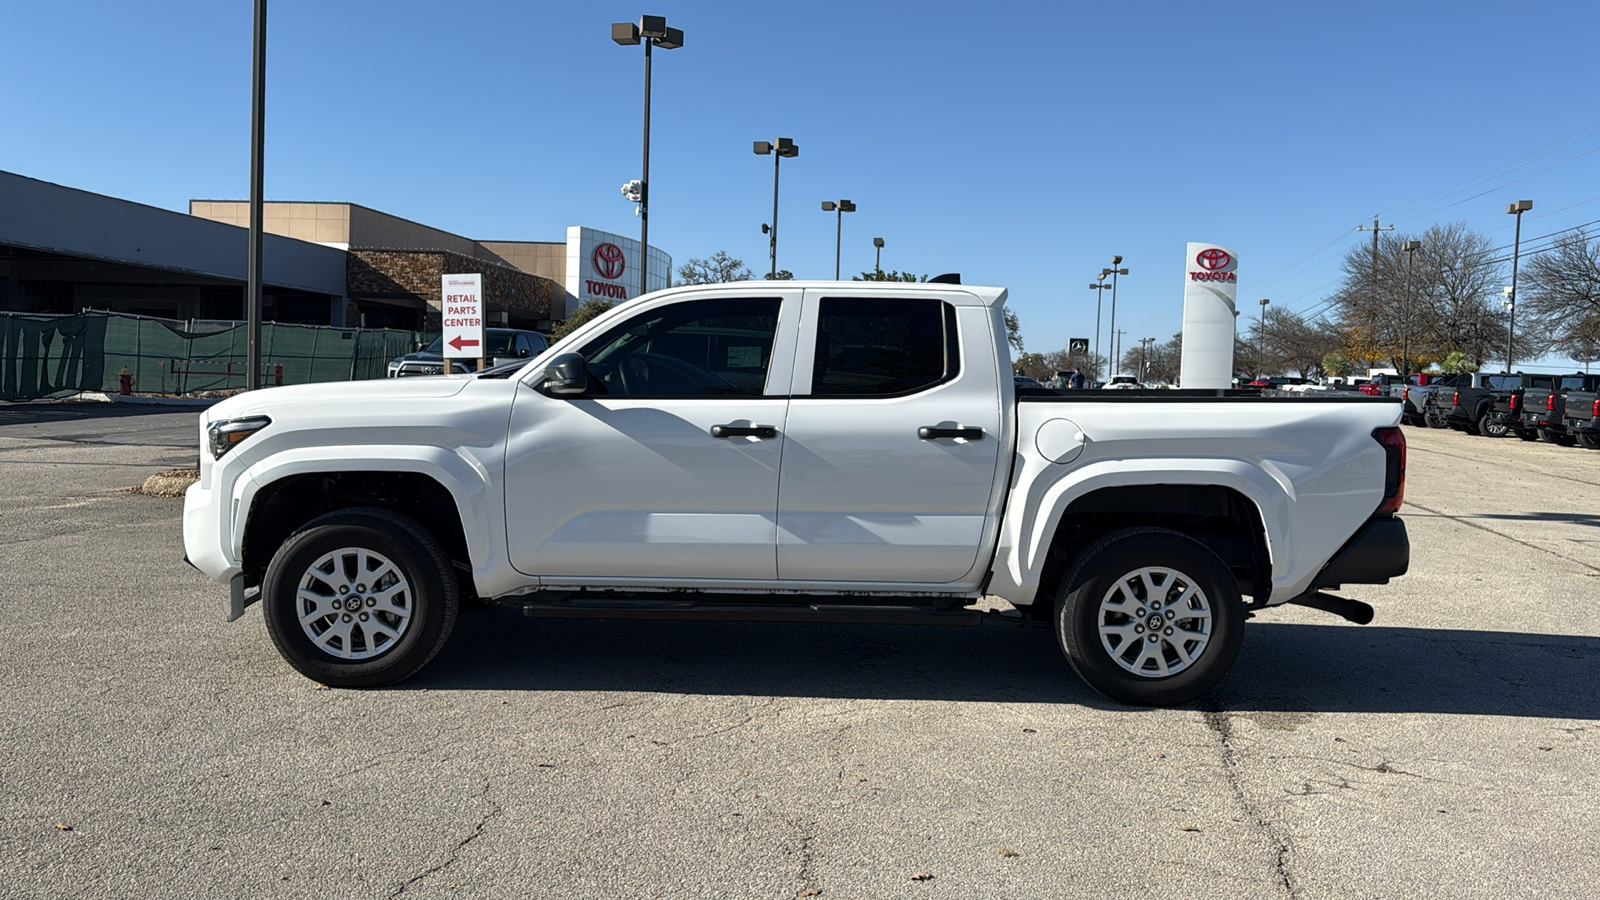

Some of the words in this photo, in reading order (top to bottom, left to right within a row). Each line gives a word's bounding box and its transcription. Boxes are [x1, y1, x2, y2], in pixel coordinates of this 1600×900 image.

[1189, 271, 1235, 280] TOYOTA
[586, 280, 627, 299] TOYOTA
[447, 295, 478, 303] RETAIL
[448, 306, 477, 315] PARTS
[444, 318, 481, 327] CENTER
